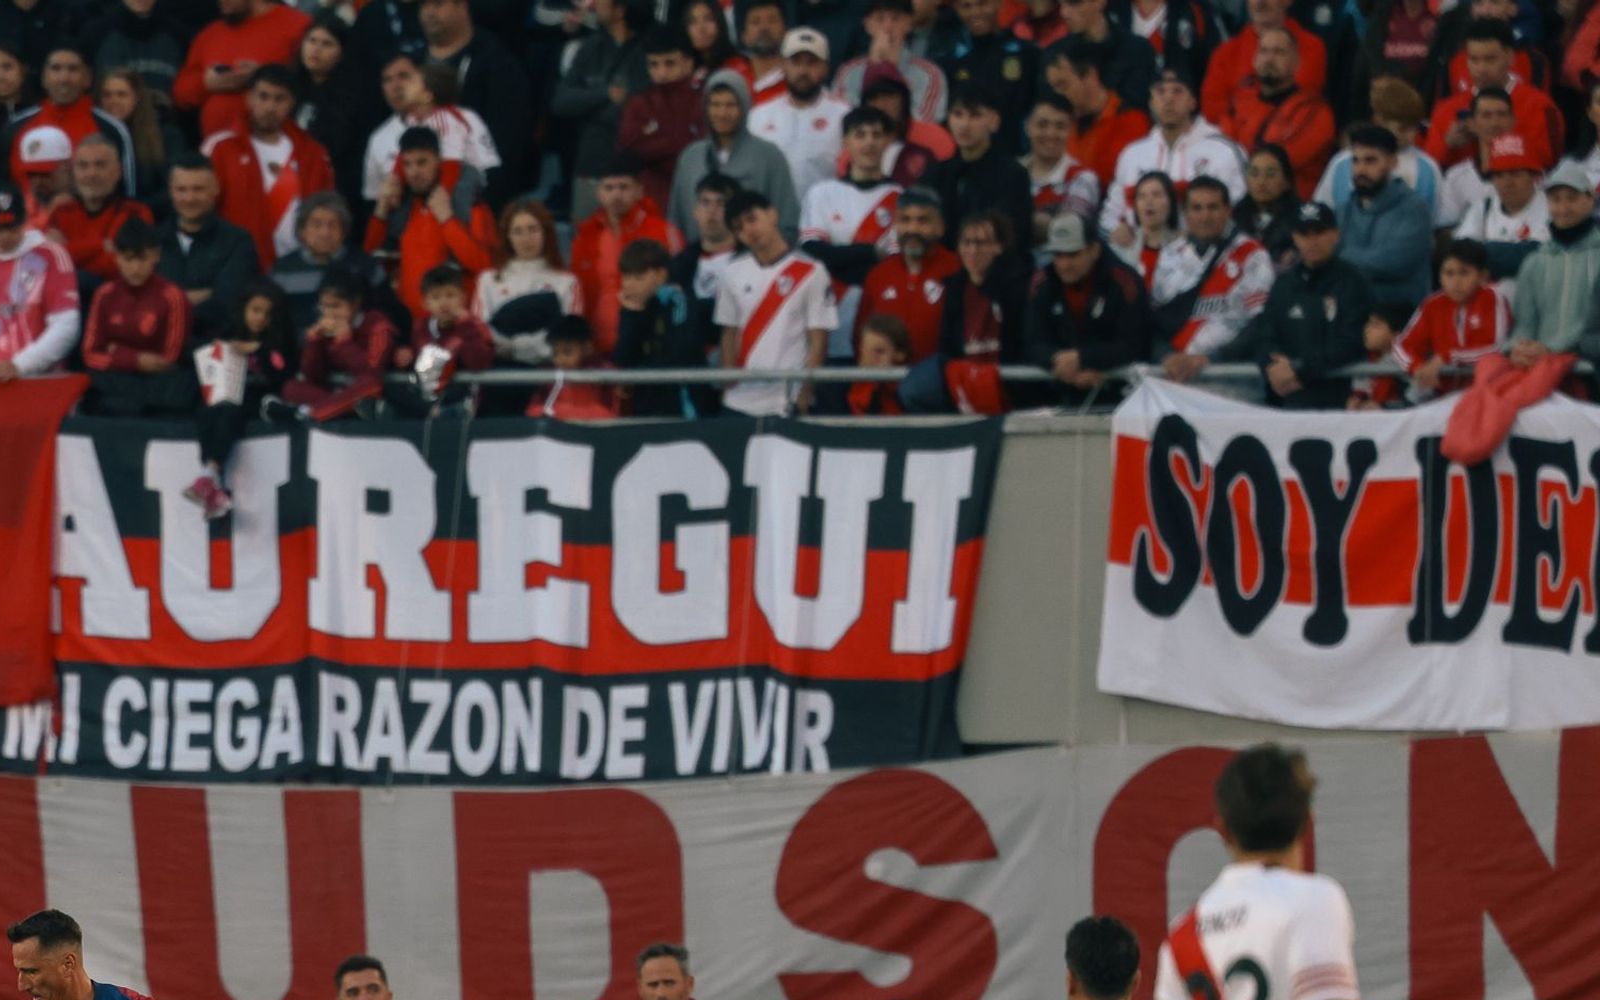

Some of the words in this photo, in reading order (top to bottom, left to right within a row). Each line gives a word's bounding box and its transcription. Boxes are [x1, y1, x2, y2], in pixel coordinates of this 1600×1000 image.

[1133, 413, 1378, 648] SOY
[1407, 435, 1600, 655] DE
[1, 672, 80, 764] MI
[103, 674, 302, 772] CIEGA
[316, 670, 542, 776] RAZON
[559, 684, 649, 780] DE
[668, 677, 834, 775] VIVIR
